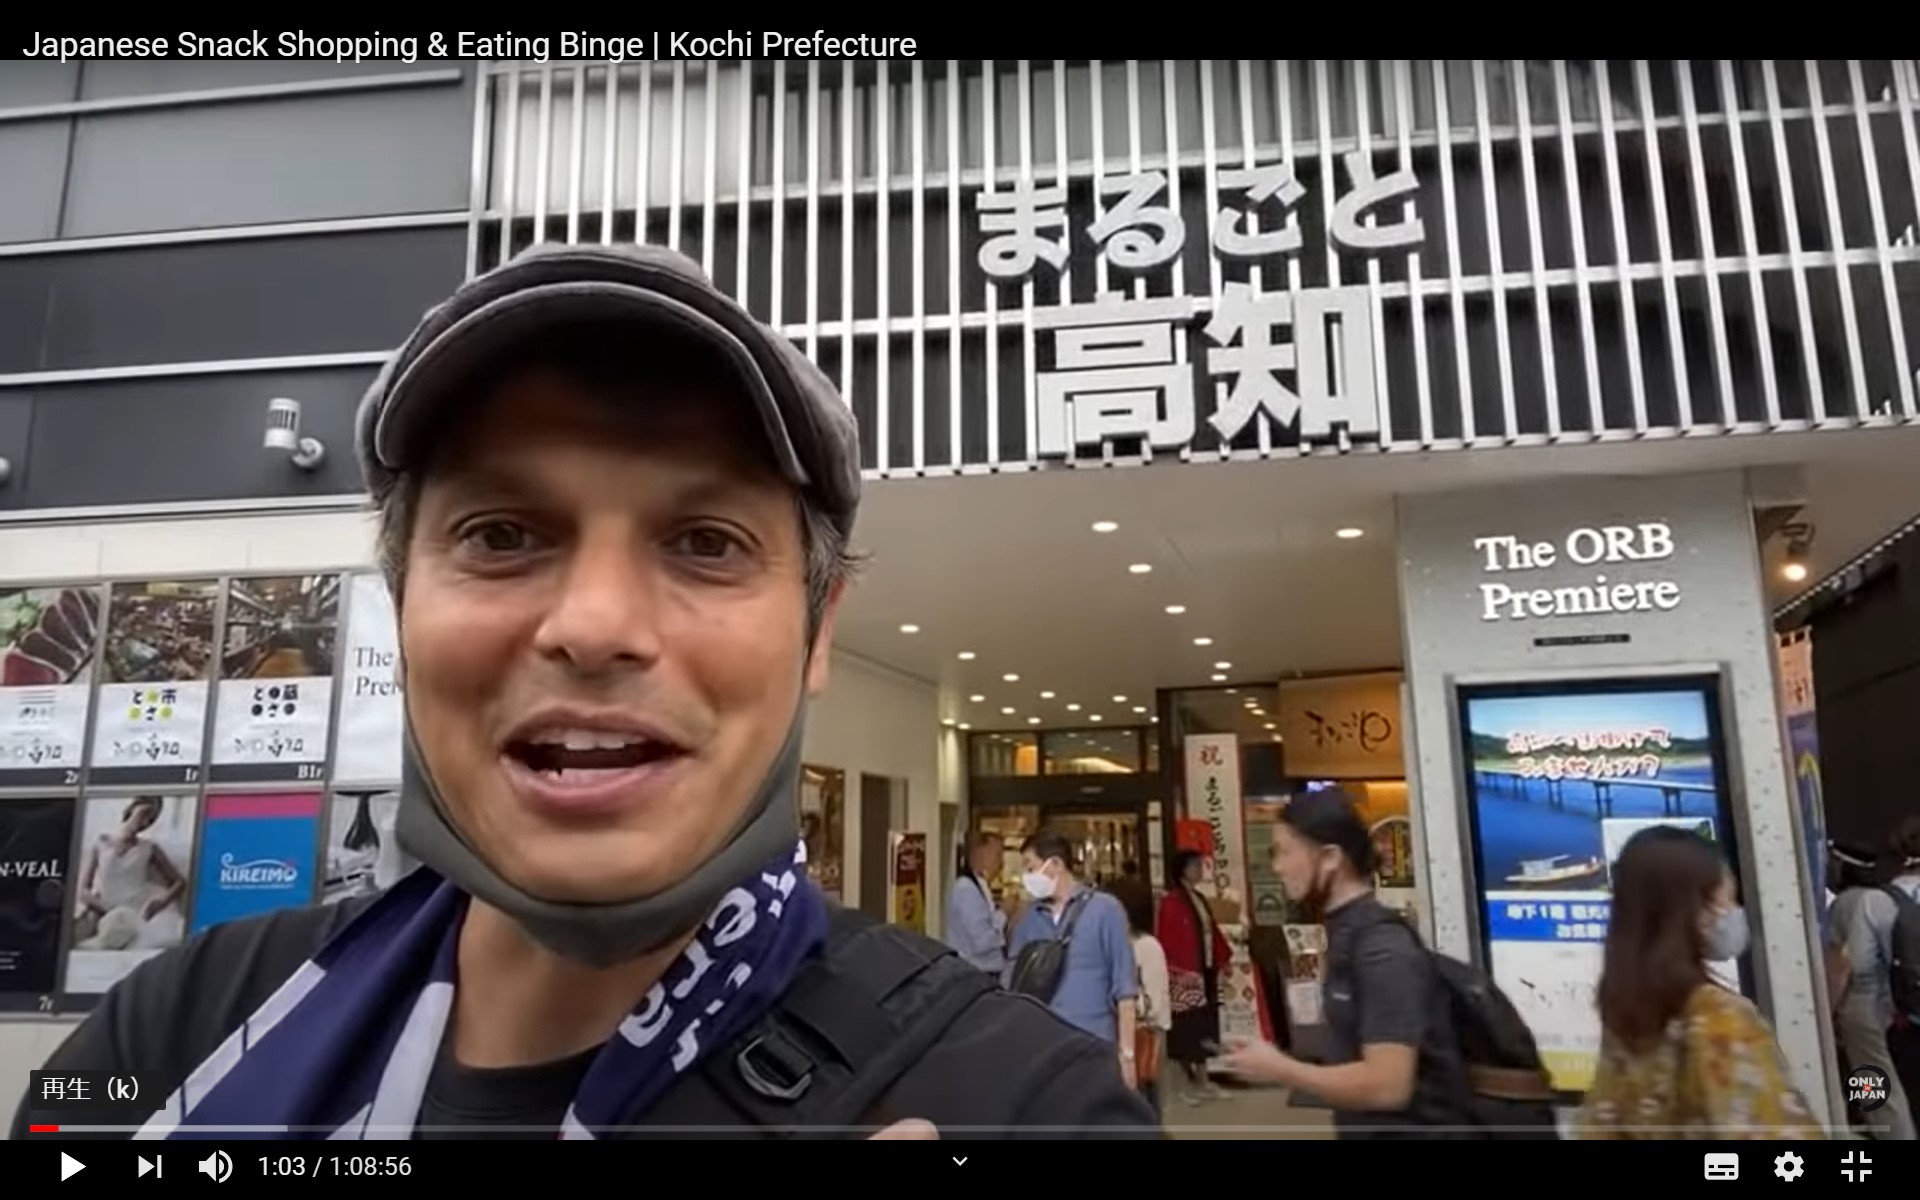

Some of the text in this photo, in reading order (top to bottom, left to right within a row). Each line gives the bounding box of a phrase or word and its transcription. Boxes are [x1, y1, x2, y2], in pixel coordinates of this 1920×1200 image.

[976, 151, 1424, 278] まるごと
[1033, 282, 1380, 456] 高知
[1475, 523, 1674, 571] The ORB
[1480, 578, 1680, 620] Premiere
[354, 647, 394, 667] The
[220, 866, 297, 883] KIREIMO
